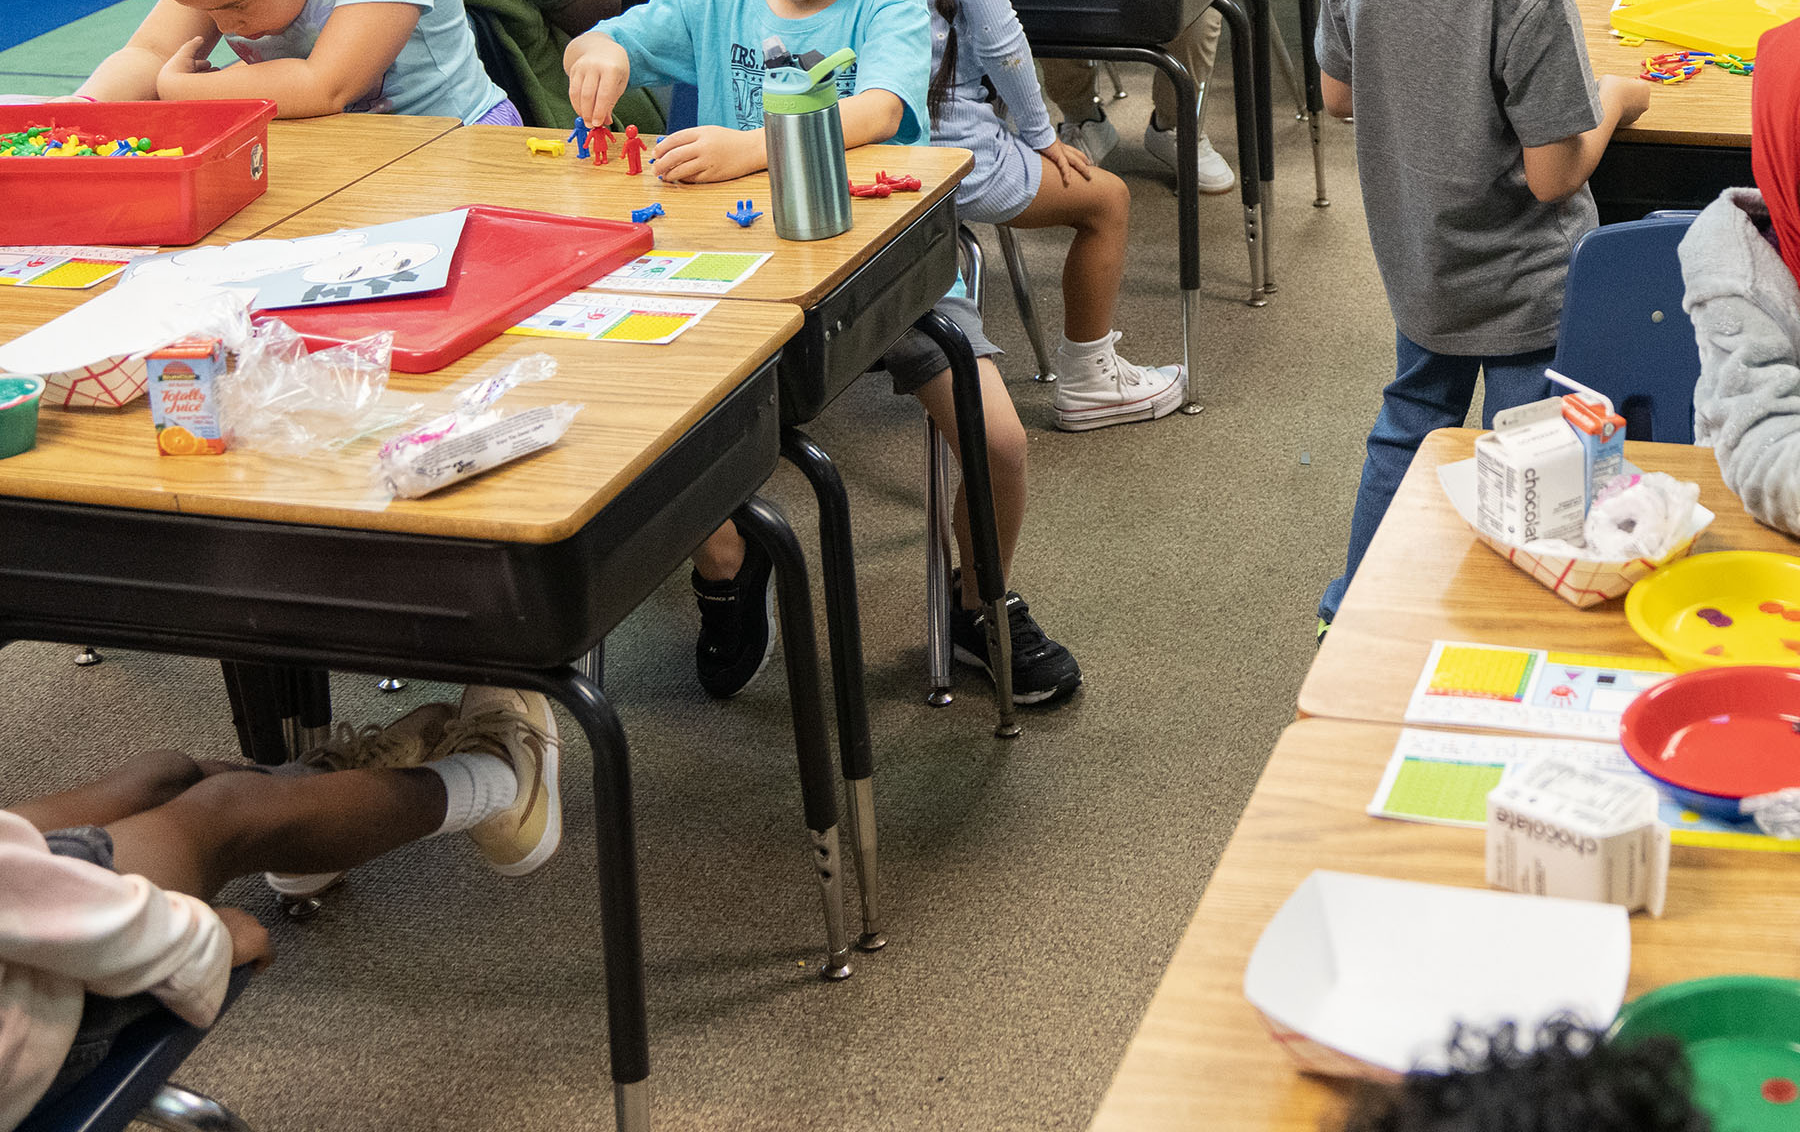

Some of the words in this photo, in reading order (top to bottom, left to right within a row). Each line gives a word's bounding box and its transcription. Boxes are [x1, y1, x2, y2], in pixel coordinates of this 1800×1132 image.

[162, 388, 206, 403] Totally
[165, 402, 201, 414] Juice
[1524, 468, 1541, 544] chocolat
[1496, 807, 1598, 855] chocolate
